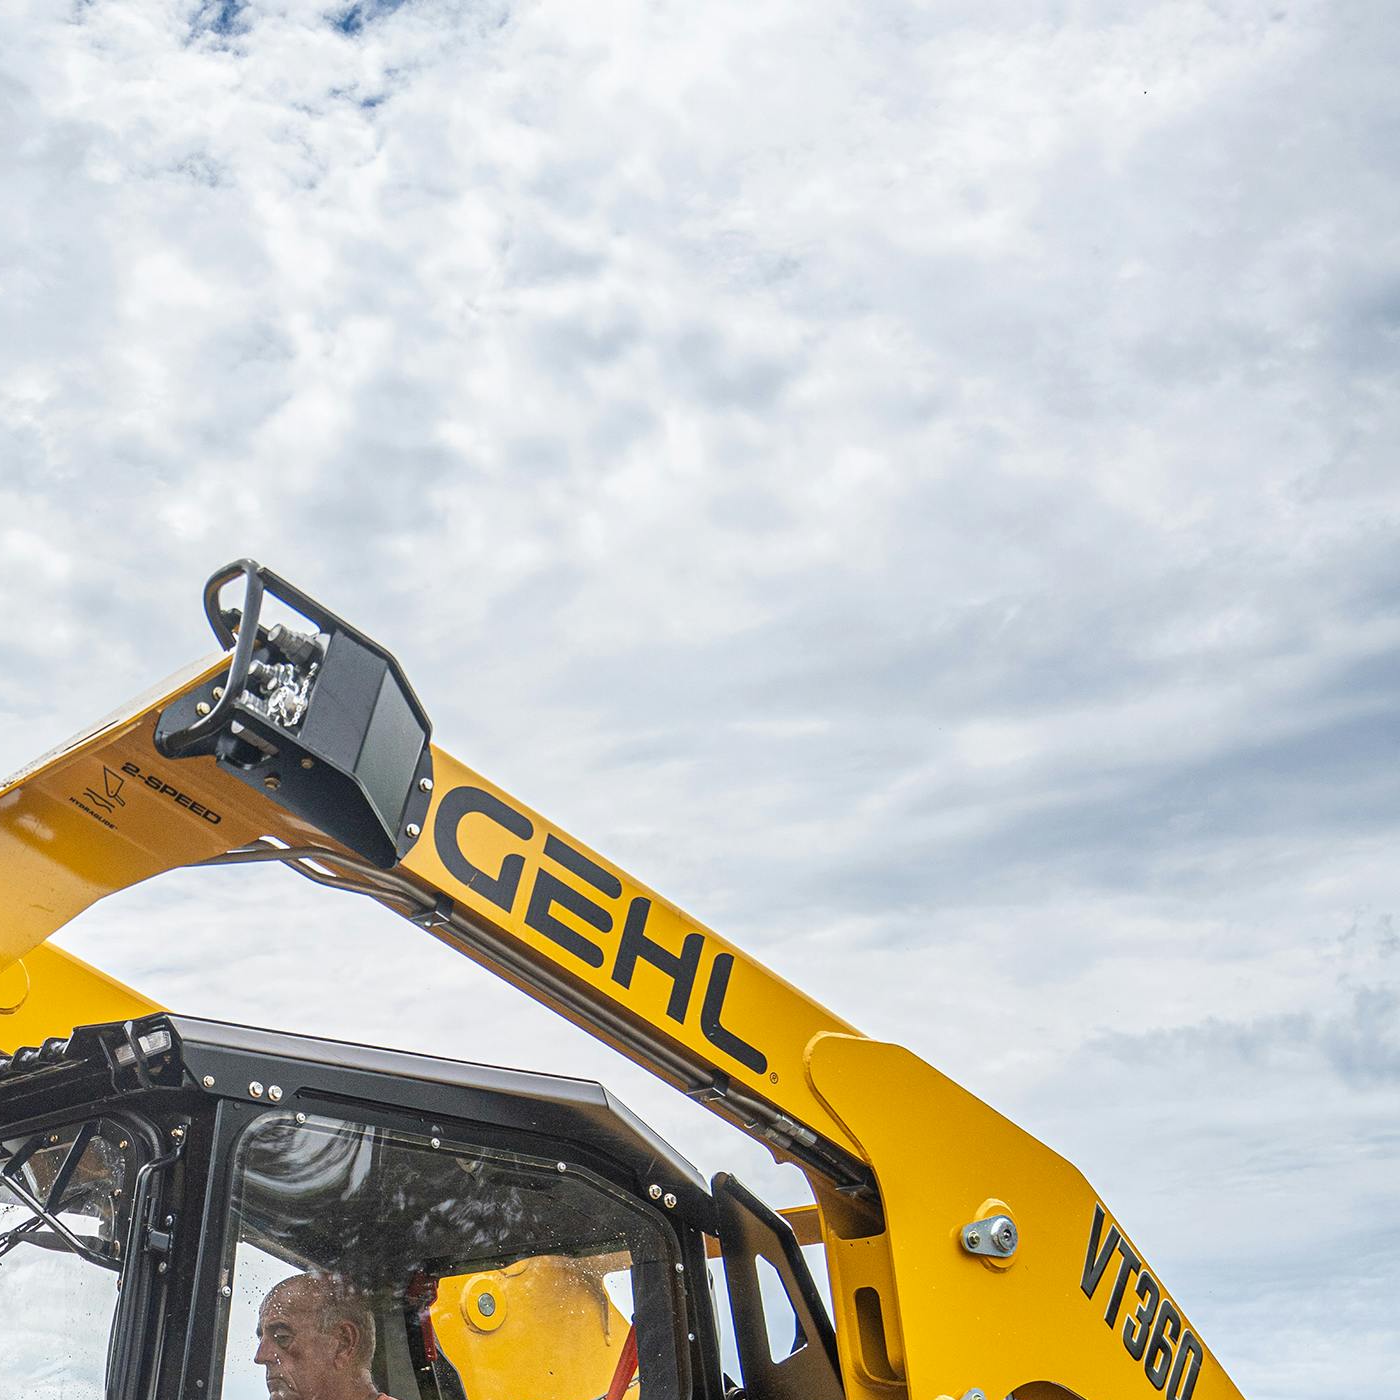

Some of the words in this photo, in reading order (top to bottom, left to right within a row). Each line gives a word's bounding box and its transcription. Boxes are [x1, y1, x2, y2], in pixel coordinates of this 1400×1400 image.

[68, 796, 116, 830] HYDRAGLIDE
[121, 762, 222, 825] 2-SPEED
[434, 786, 768, 1075] GEHL
